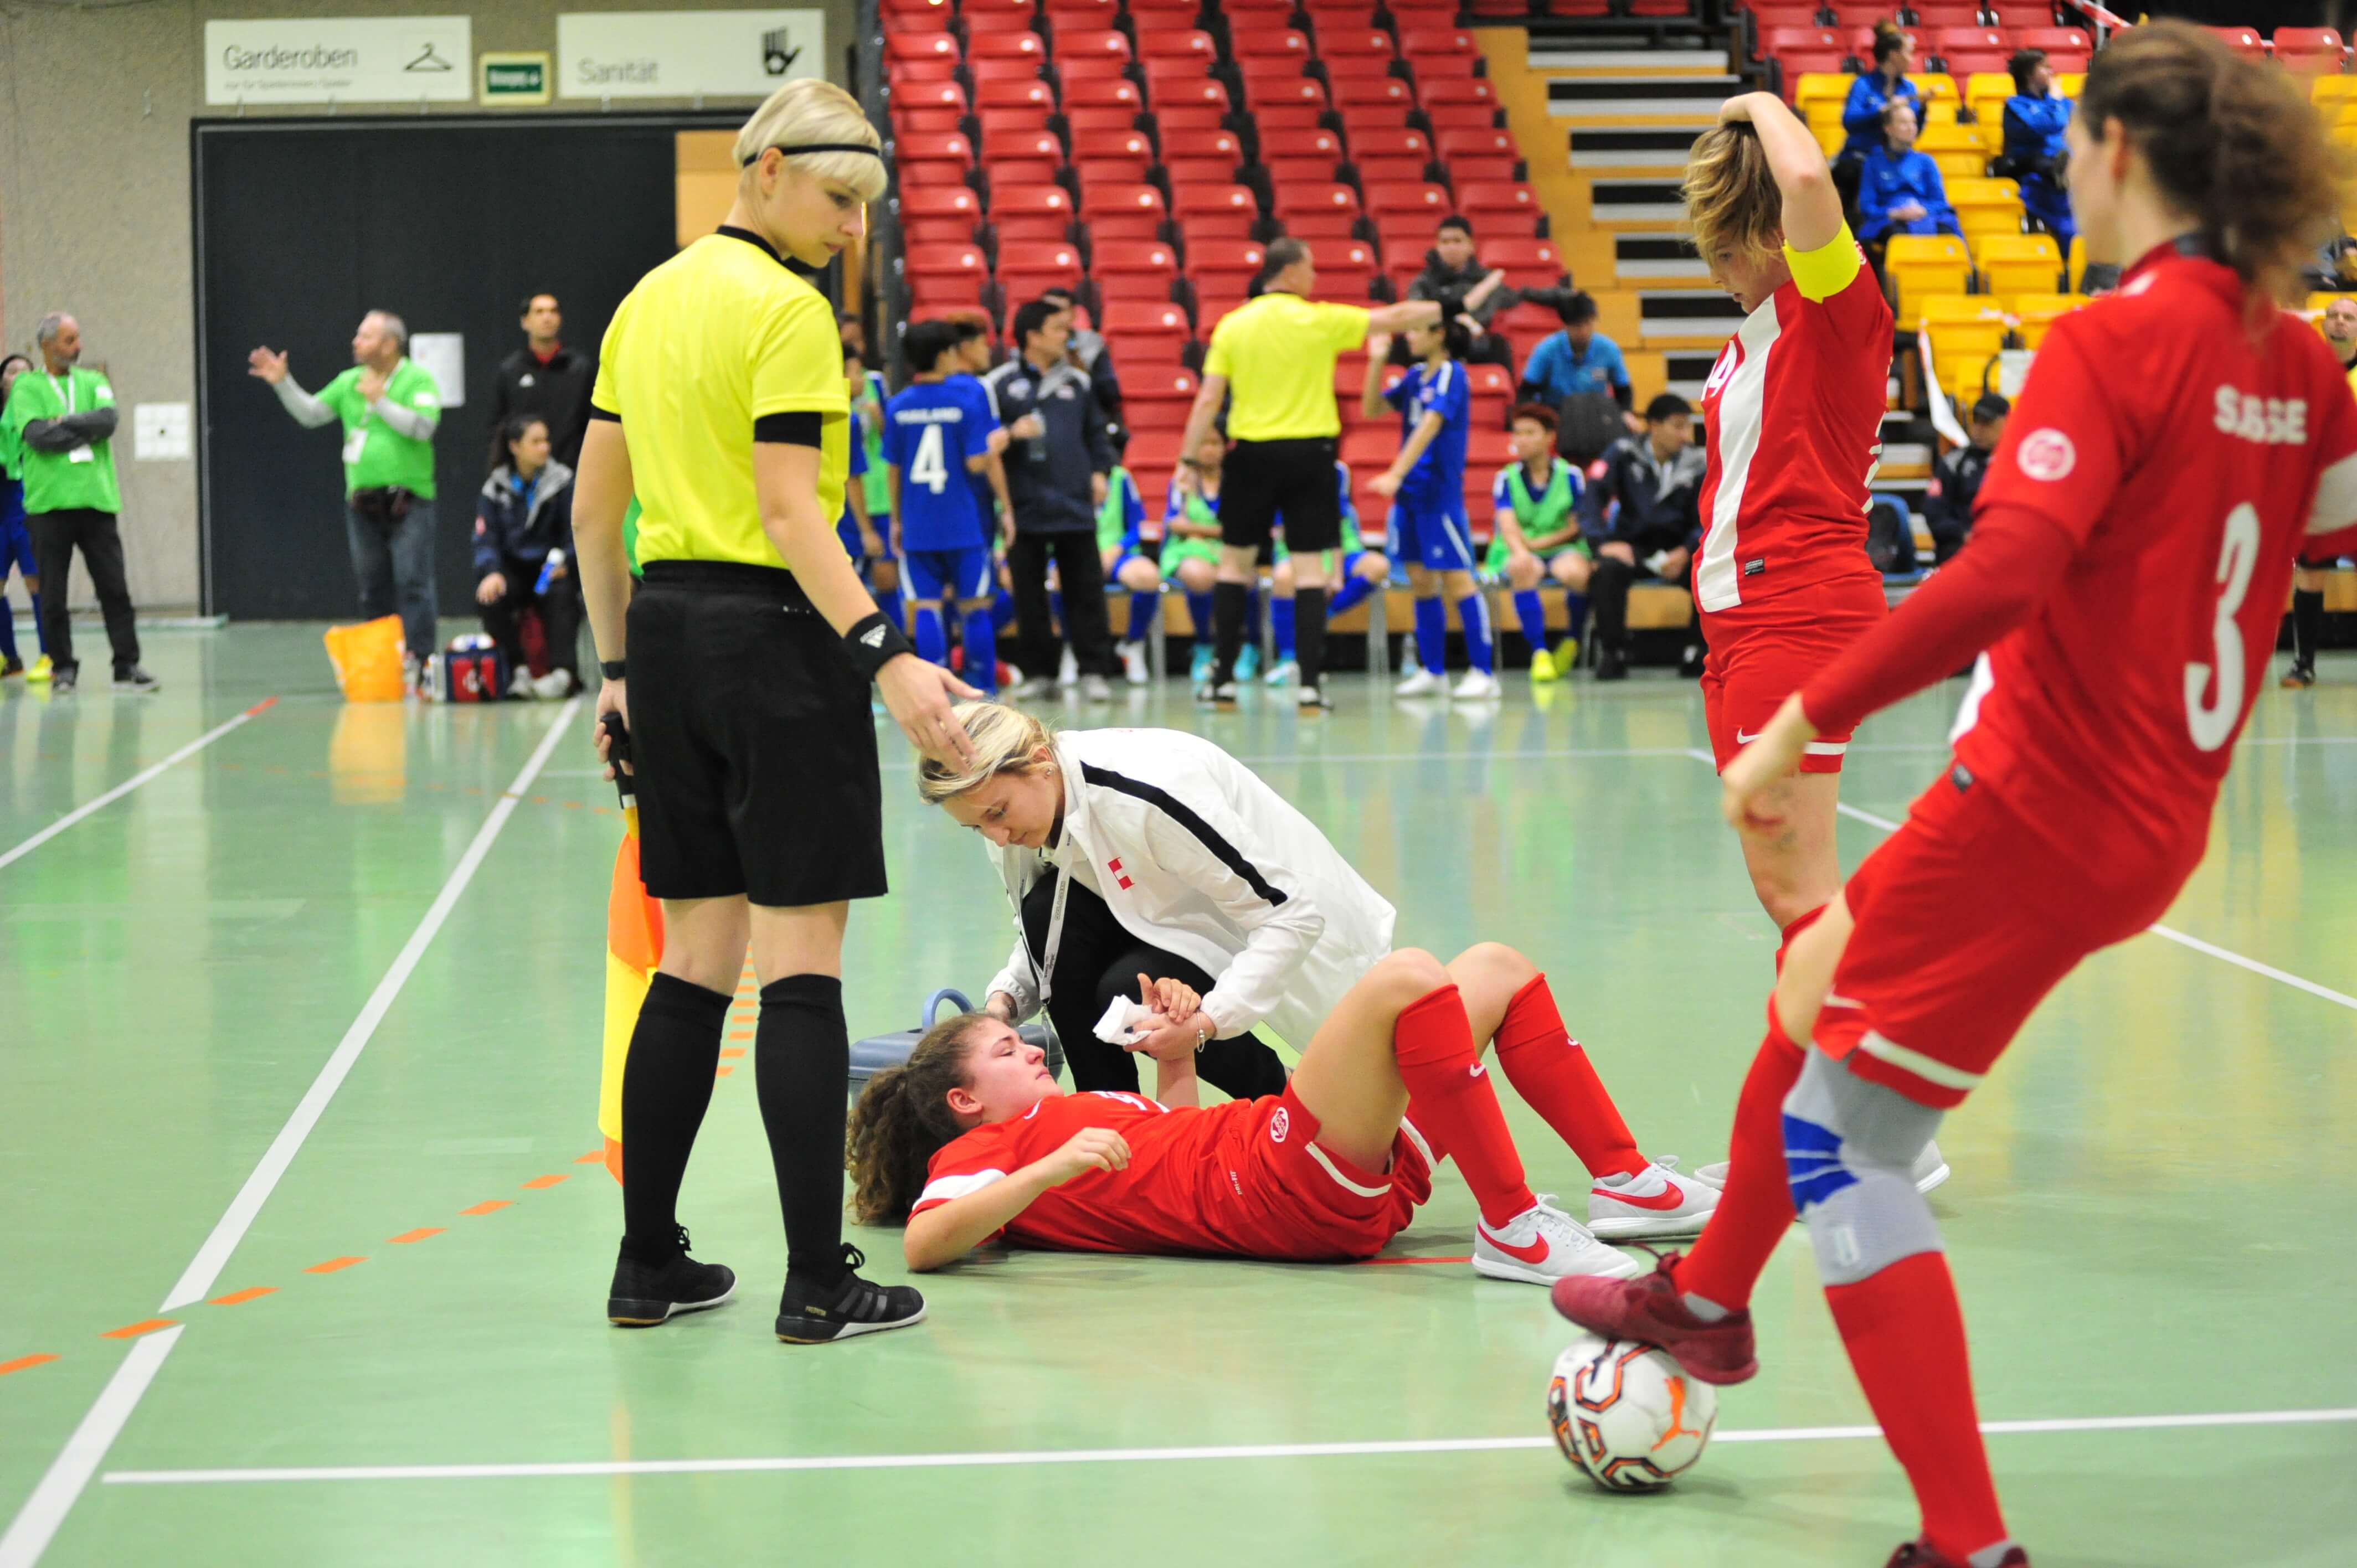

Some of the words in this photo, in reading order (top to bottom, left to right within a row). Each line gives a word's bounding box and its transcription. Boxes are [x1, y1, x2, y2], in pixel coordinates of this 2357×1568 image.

[223, 43, 358, 70] Garderoben
[578, 58, 658, 85] Sanität
[909, 424, 949, 494] 4
[2184, 501, 2261, 752] 3
